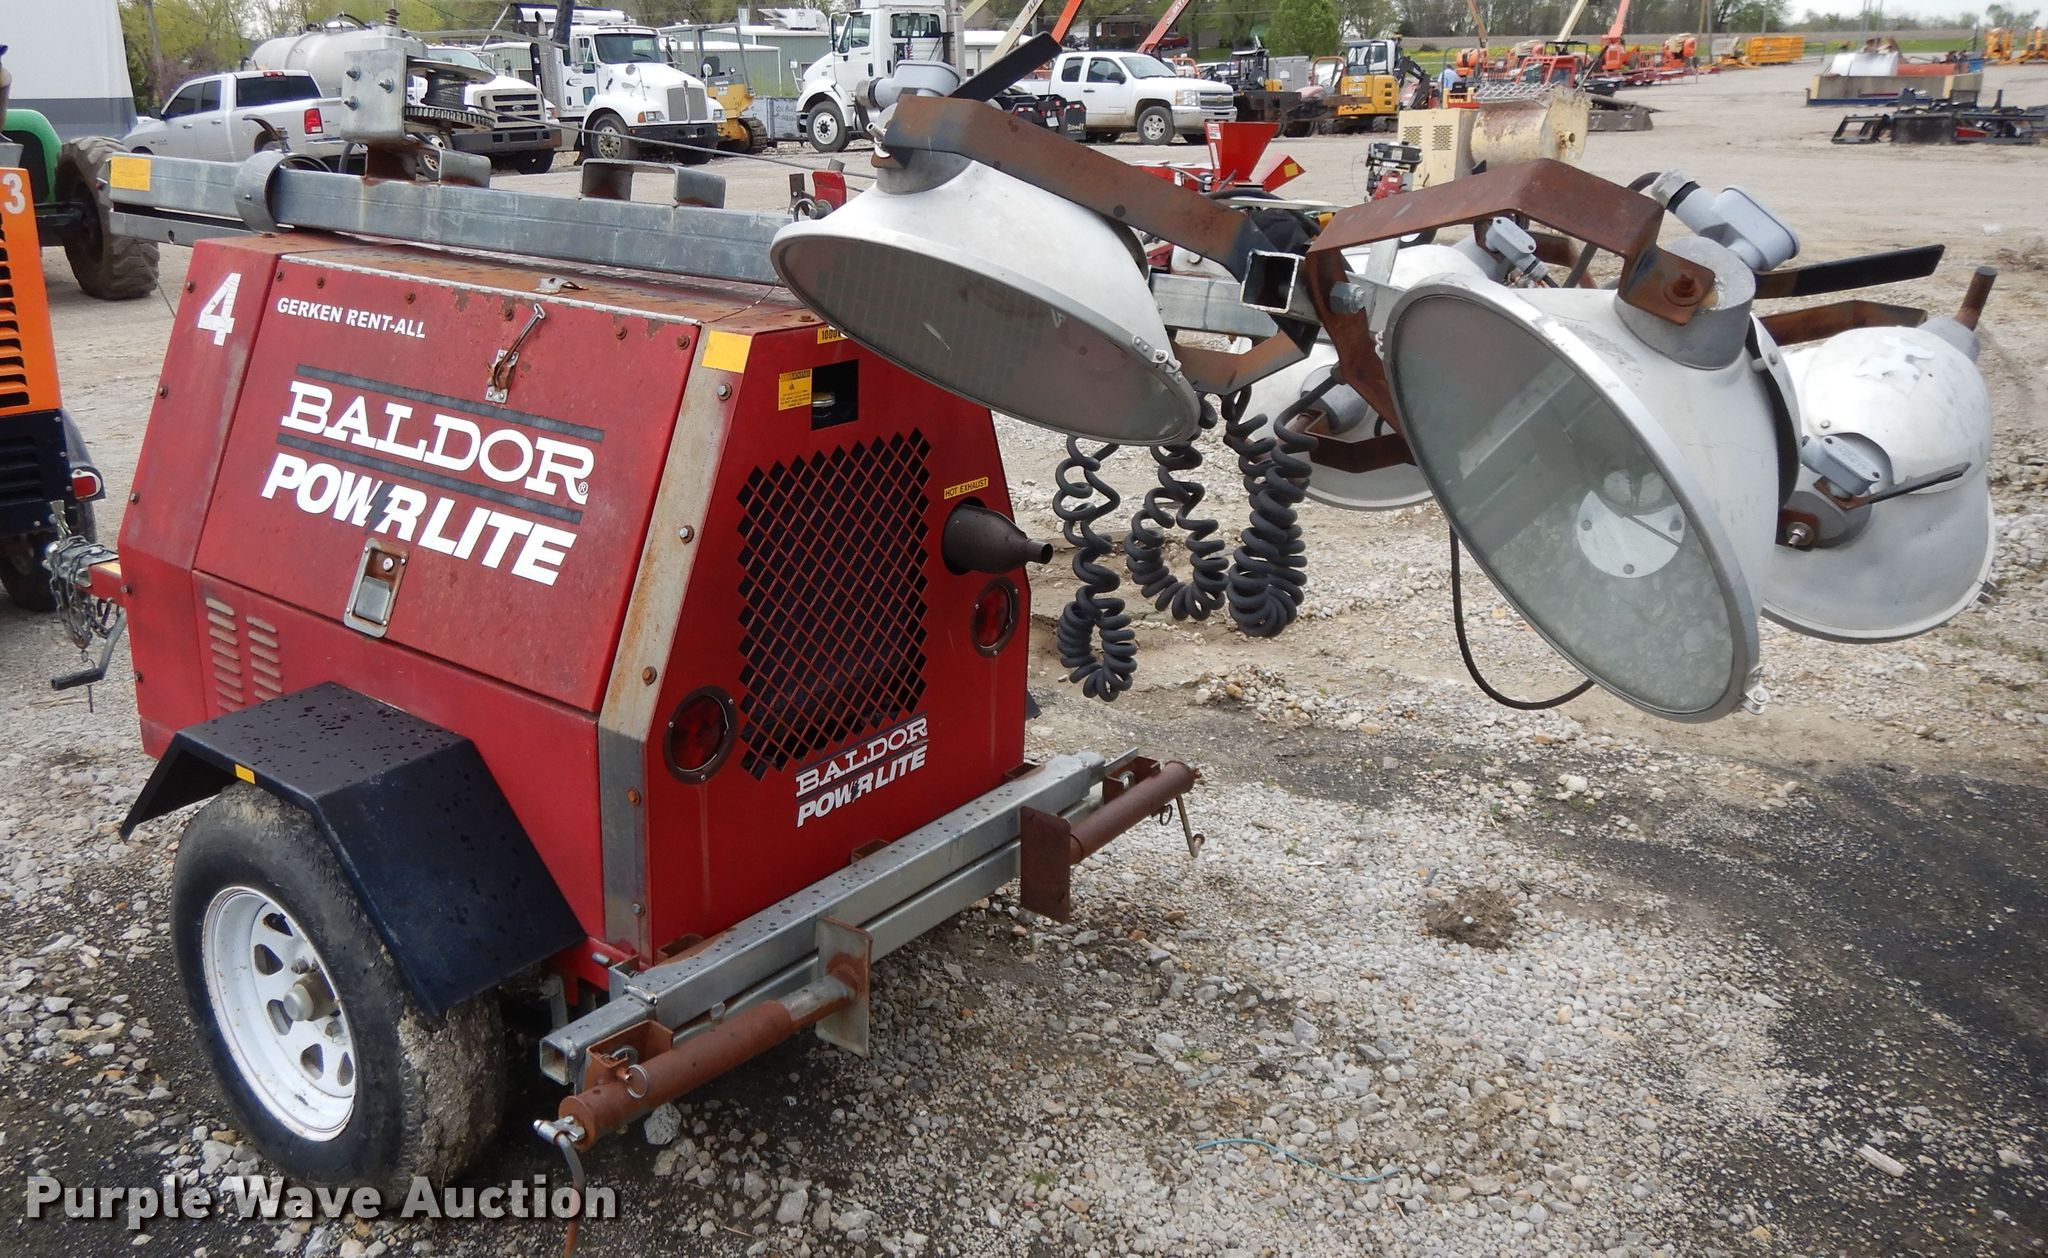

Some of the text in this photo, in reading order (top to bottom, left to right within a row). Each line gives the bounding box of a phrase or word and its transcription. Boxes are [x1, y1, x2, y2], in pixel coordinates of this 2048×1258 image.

[2, 173, 26, 215] 3
[197, 272, 241, 346] 4
[277, 297, 426, 339] GERKEN RENT-ALL
[280, 380, 596, 506] BALDOR
[945, 478, 988, 498] HOT EXHAUST
[795, 717, 928, 797] BALDOR
